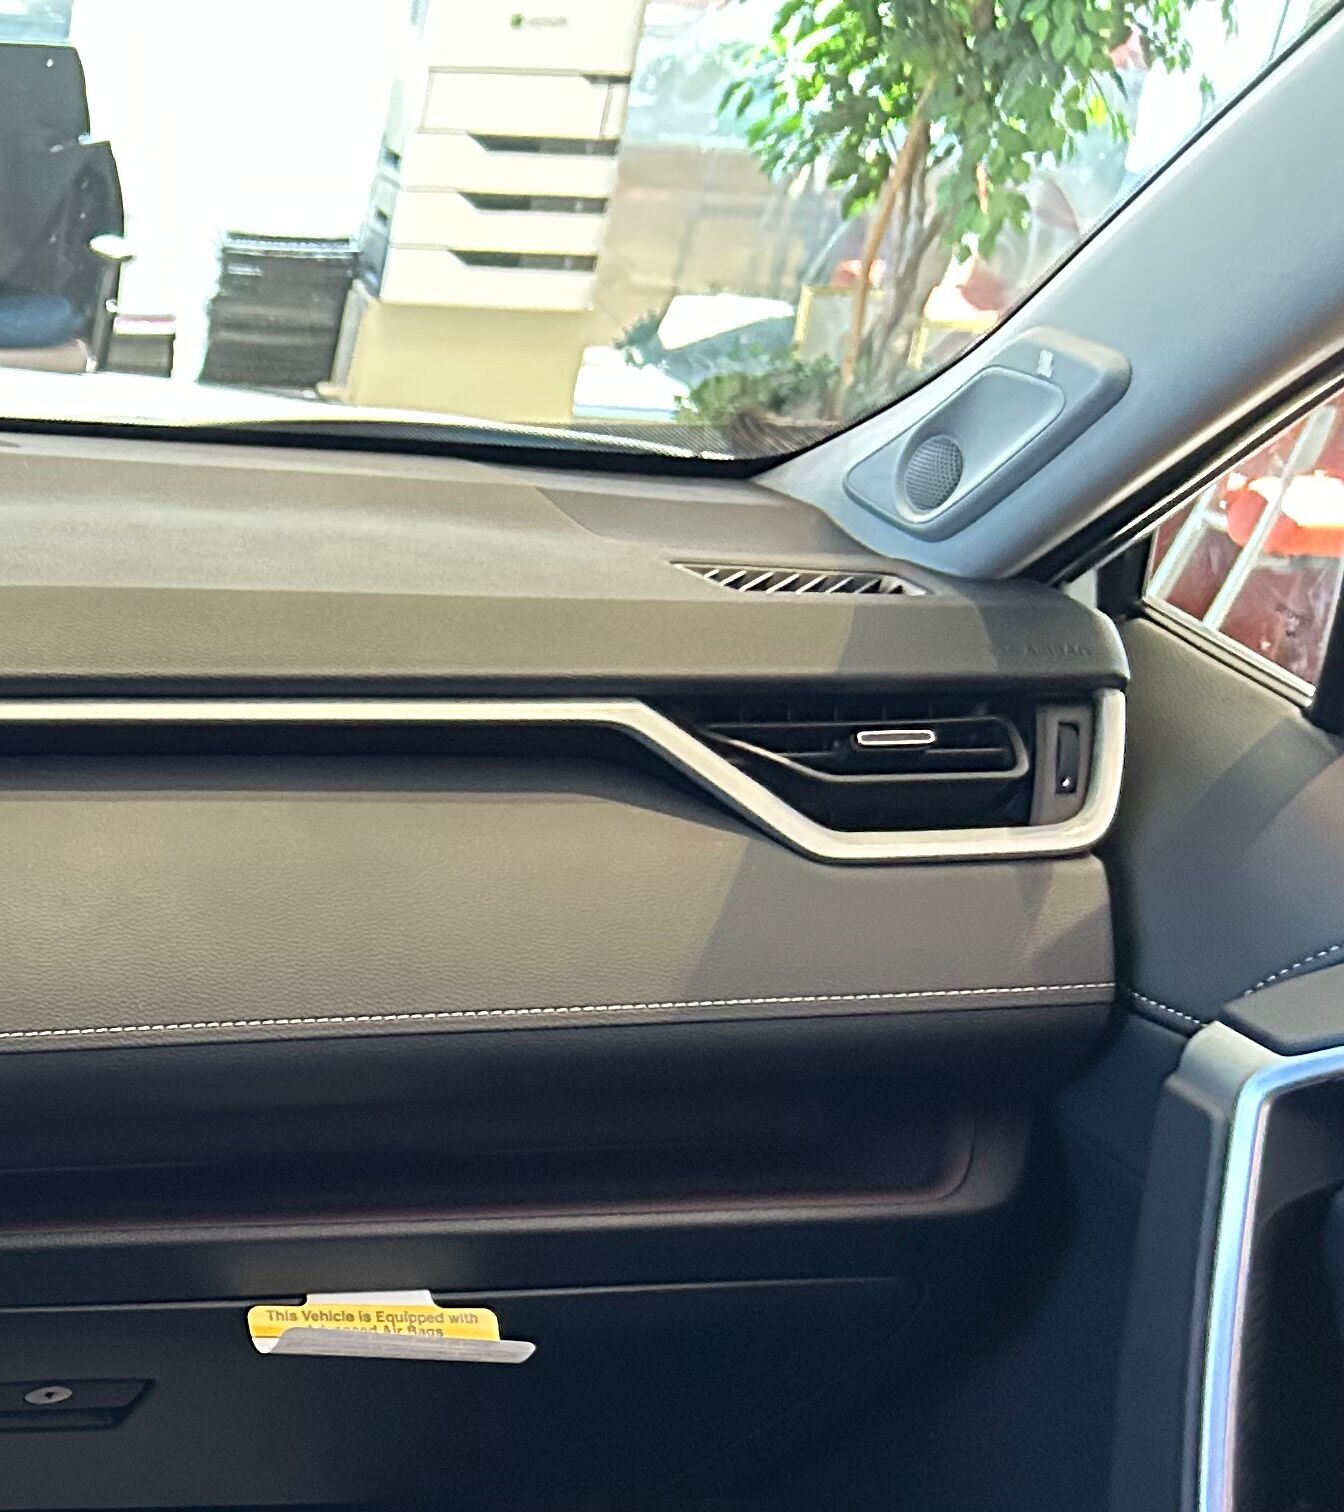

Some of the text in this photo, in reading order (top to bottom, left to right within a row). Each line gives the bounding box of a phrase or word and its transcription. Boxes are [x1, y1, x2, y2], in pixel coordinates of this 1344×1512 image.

[266, 1309, 479, 1327] This Vehicle is Equipped with
